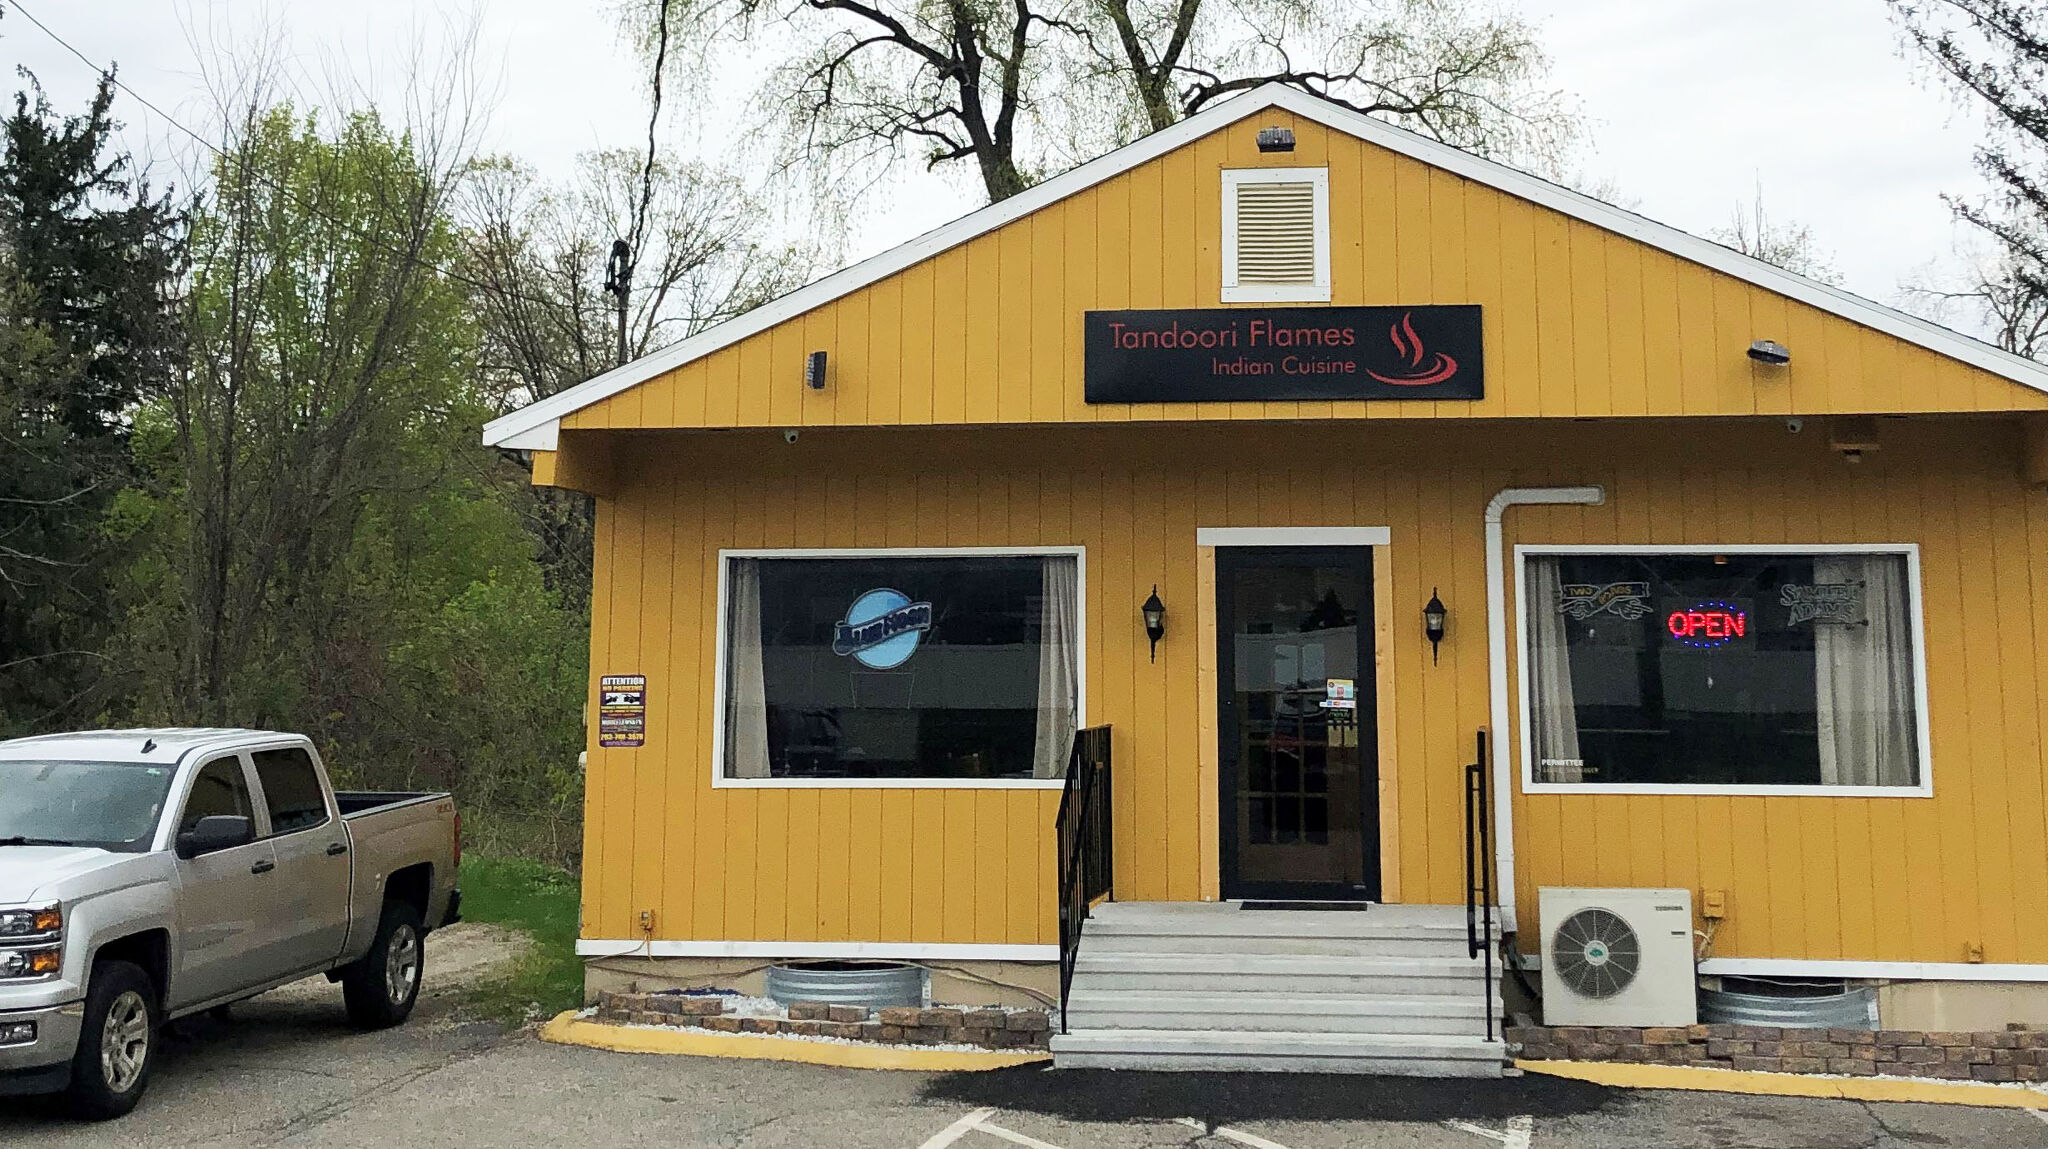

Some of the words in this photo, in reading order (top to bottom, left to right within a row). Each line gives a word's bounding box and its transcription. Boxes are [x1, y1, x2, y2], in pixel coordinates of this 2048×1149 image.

[1109, 321, 1238, 349] Tandoori
[1250, 319, 1355, 347] Flames
[1213, 356, 1274, 376] Indian
[1281, 354, 1357, 375] Cuisine
[1668, 610, 1746, 637] OPEN
